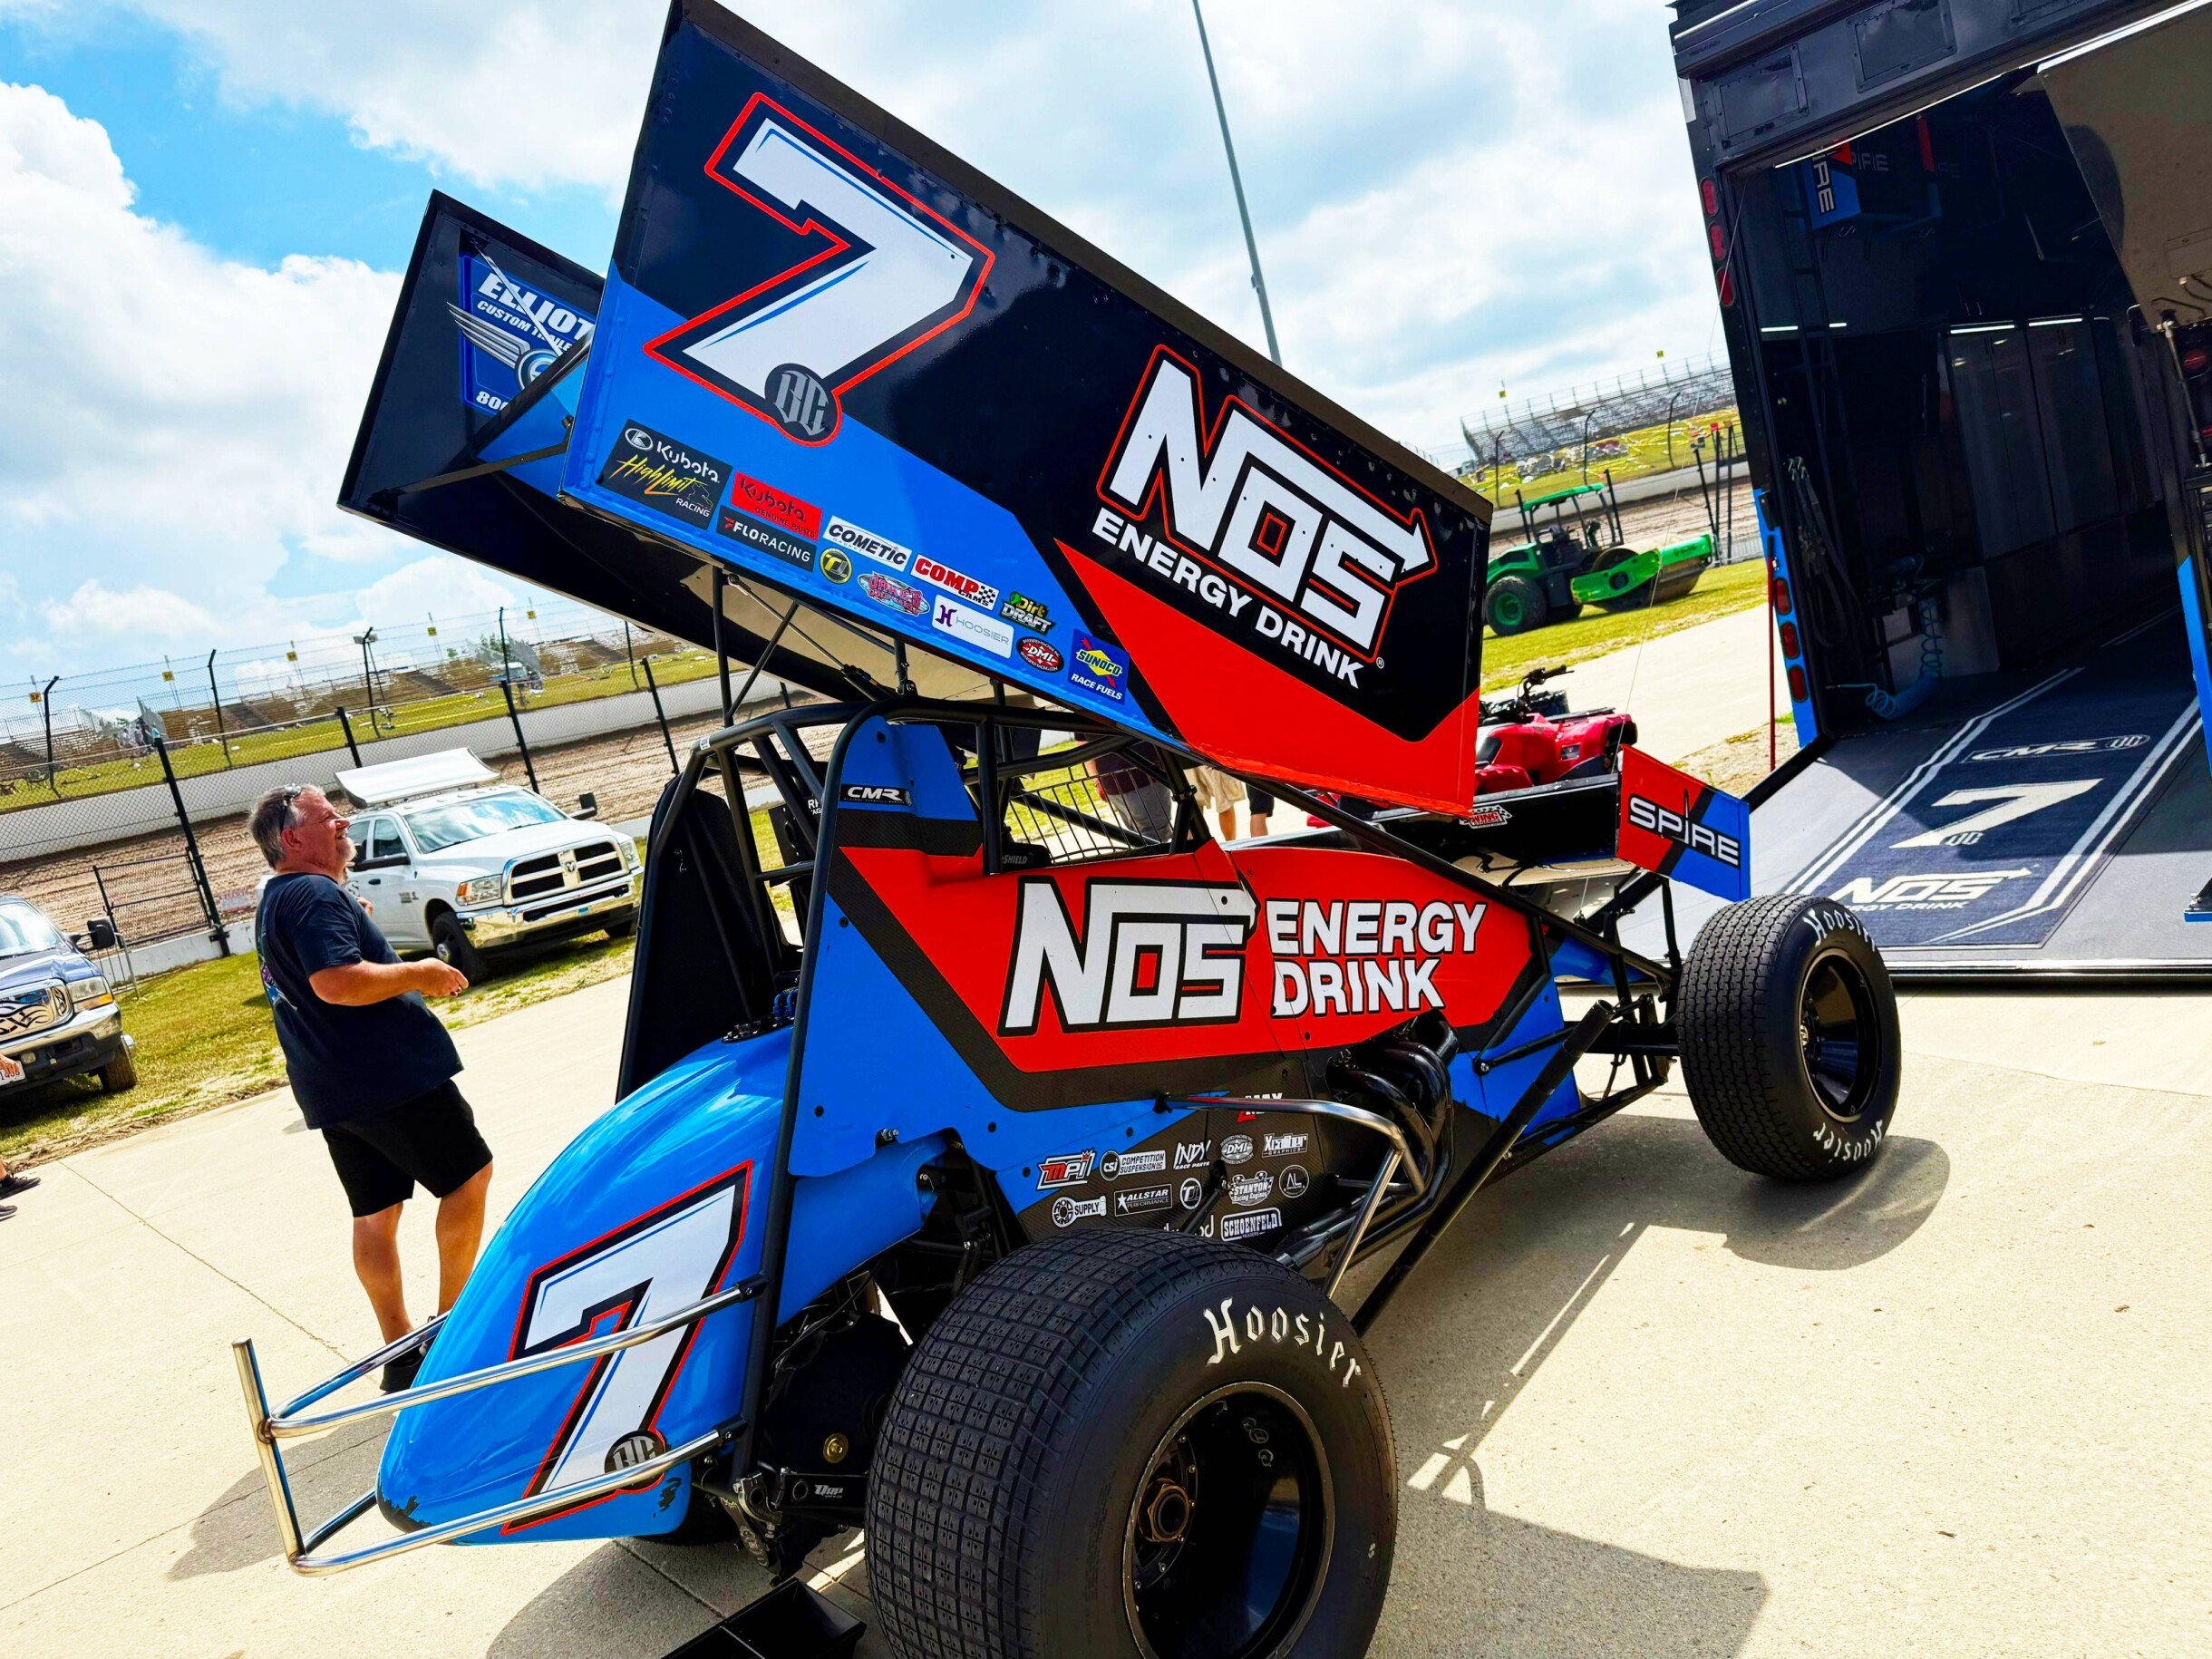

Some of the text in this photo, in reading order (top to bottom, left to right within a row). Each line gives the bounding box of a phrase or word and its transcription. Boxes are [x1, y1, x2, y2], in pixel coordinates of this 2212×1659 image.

[662, 104, 985, 408] 7
[477, 300, 531, 332] CUSTOM
[656, 441, 719, 483] Kubota
[675, 498, 711, 517] RACING
[740, 477, 807, 522] Kubota
[1110, 359, 1430, 650] NOS
[754, 507, 816, 538] GENUINE PARTS
[829, 524, 907, 565] COMETIC
[915, 558, 979, 595] COMP
[958, 589, 990, 606] CAMS
[1016, 597, 1046, 616] Dirt
[1091, 508, 1364, 689] ENERGY DRINK
[956, 616, 1010, 645] HOOSIER
[1001, 602, 1052, 632] DRAFT
[1028, 645, 1053, 662] DMI
[1077, 650, 1122, 676] SUNOCO
[1072, 674, 1123, 700] RACE FUELS
[1971, 742, 2097, 761] CMR
[848, 786, 903, 801] CMR
[1629, 788, 1740, 866] SPIRE
[1888, 778, 2105, 849] 7
[1002, 854, 1028, 864] SHIELD
[1829, 867, 2033, 904] NOS
[1268, 901, 1486, 955] ENERGY
[1802, 908, 1875, 952] Hoosier
[1005, 882, 1257, 1028] NOS
[1271, 957, 1446, 1016] DRINK
[1121, 1153, 1164, 1166] COMPETITION
[1173, 1140, 1211, 1169] INDY
[1227, 1143, 1247, 1154] DMI
[1120, 1164, 1156, 1173] SUSPENSION
[1127, 1188, 1169, 1201] ALLSTAR
[1127, 1198, 1169, 1208] PERFORMANCE
[1234, 1182, 1268, 1195] STANTON
[1074, 1202, 1100, 1215] SUPPLY
[1224, 1213, 1278, 1237] SCHOENFELD
[513, 1169, 745, 1509] 7
[1203, 1297, 1362, 1388] Hoosier
